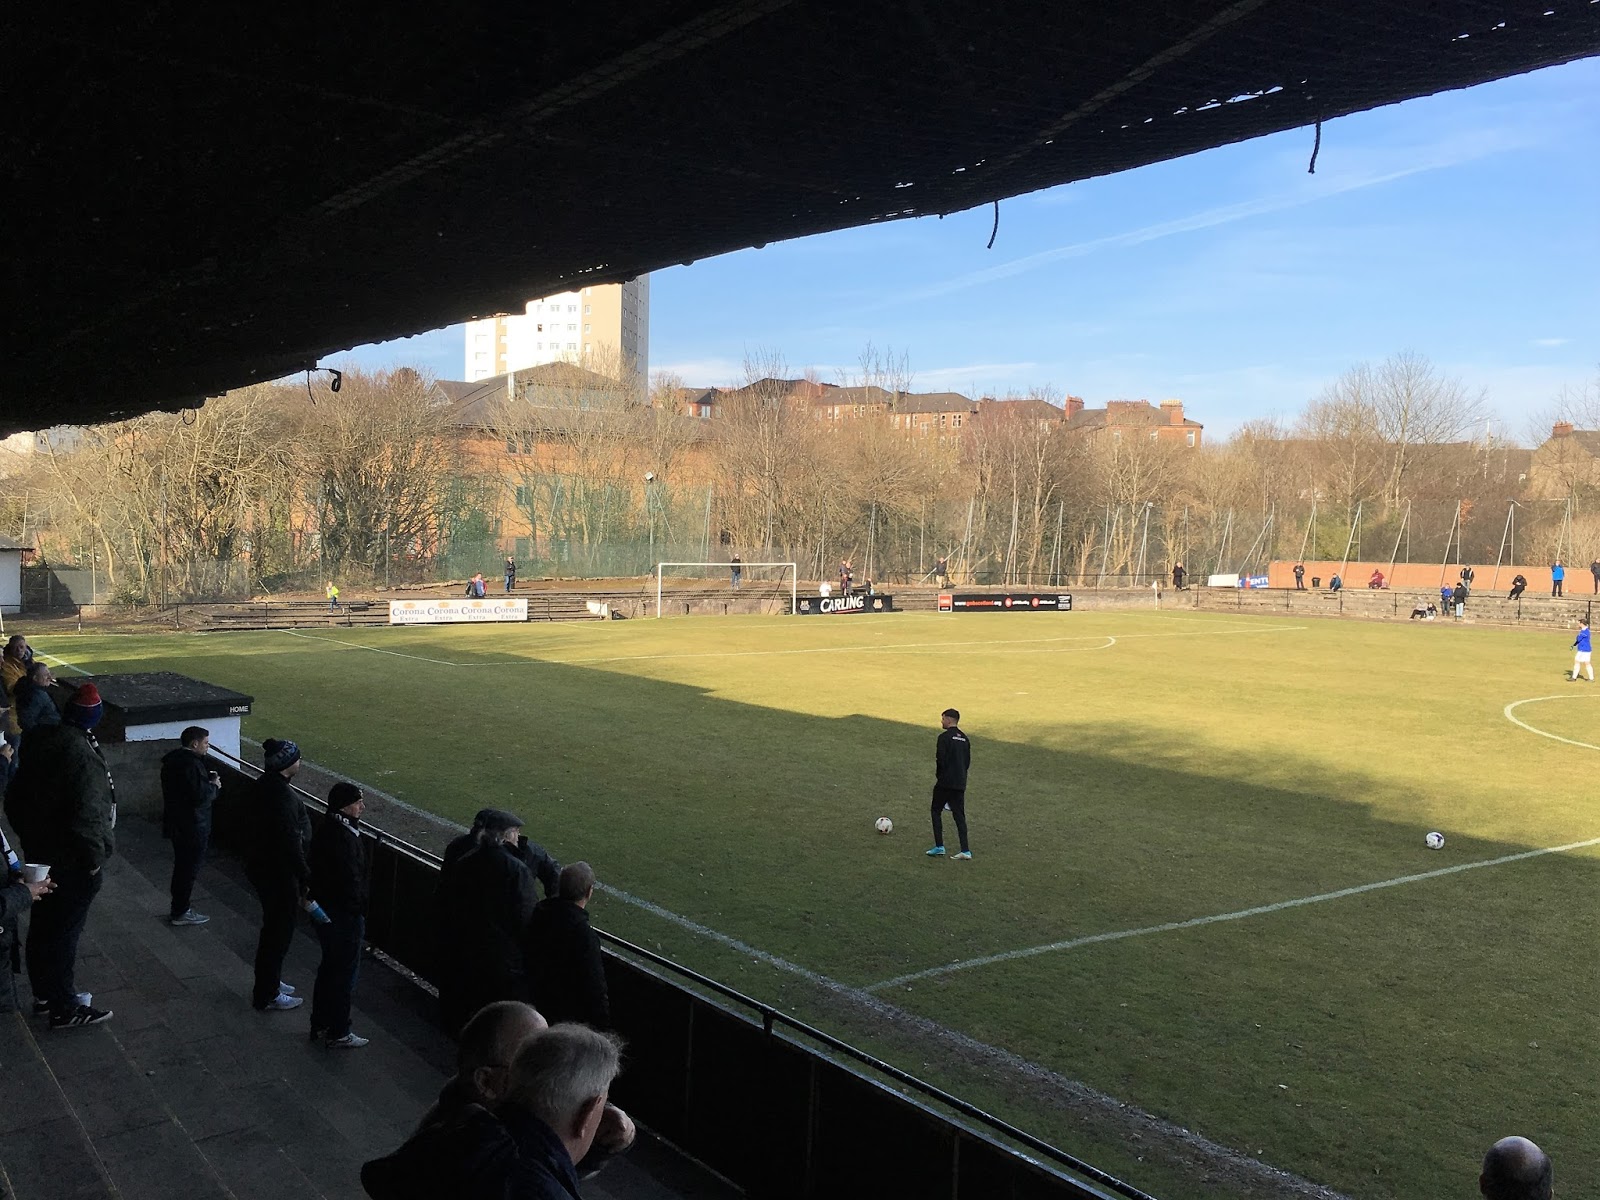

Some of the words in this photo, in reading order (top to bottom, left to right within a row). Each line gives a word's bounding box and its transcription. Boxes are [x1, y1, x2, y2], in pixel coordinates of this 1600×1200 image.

[820, 595, 864, 612] CARLING
[392, 608, 425, 616] Corona
[427, 607, 459, 615] Corona
[461, 606, 492, 614] Corona
[494, 606, 524, 614] Corona
[229, 705, 249, 713] HOME
